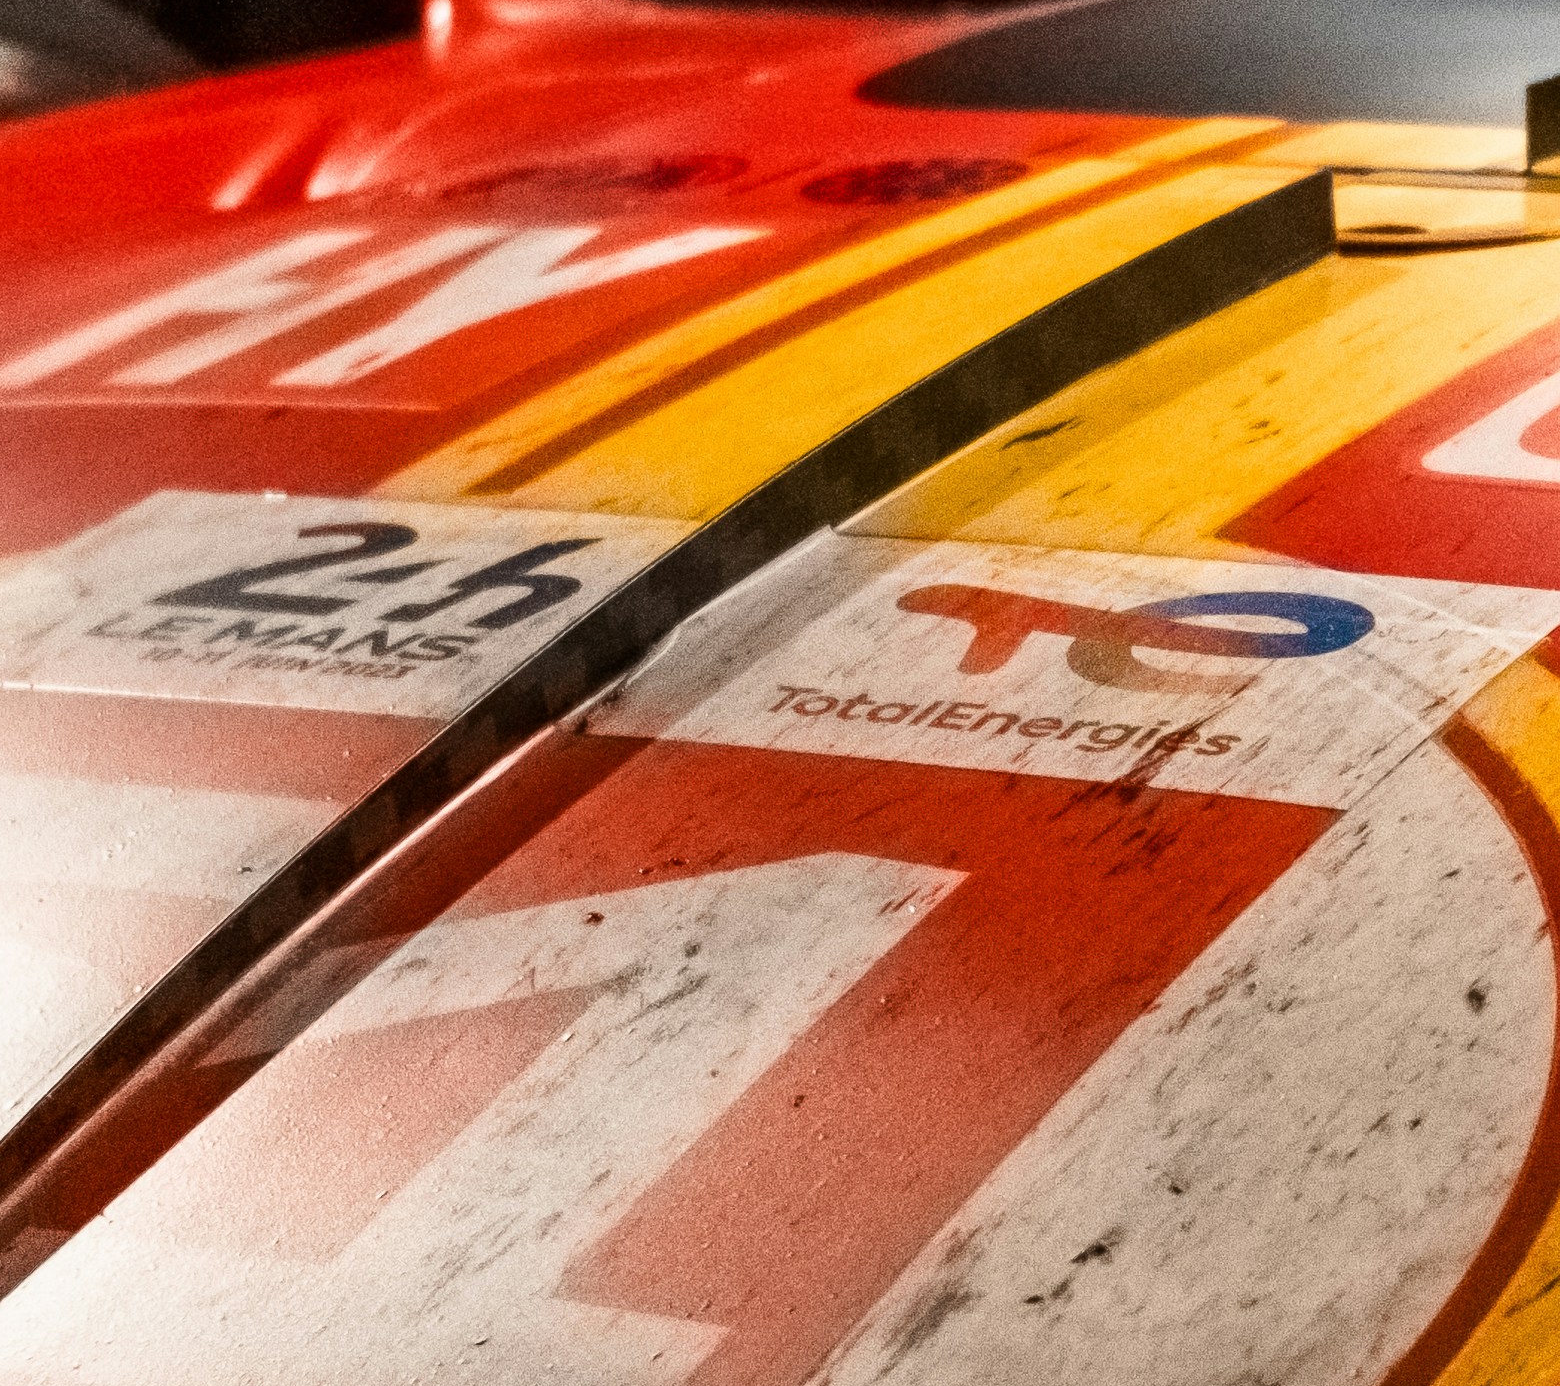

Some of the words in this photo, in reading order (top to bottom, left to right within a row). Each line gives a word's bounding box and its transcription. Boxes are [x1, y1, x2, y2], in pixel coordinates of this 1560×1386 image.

[85, 612, 215, 643] LE
[202, 616, 478, 662] MANS
[767, 684, 1243, 757] TotalEnergies
